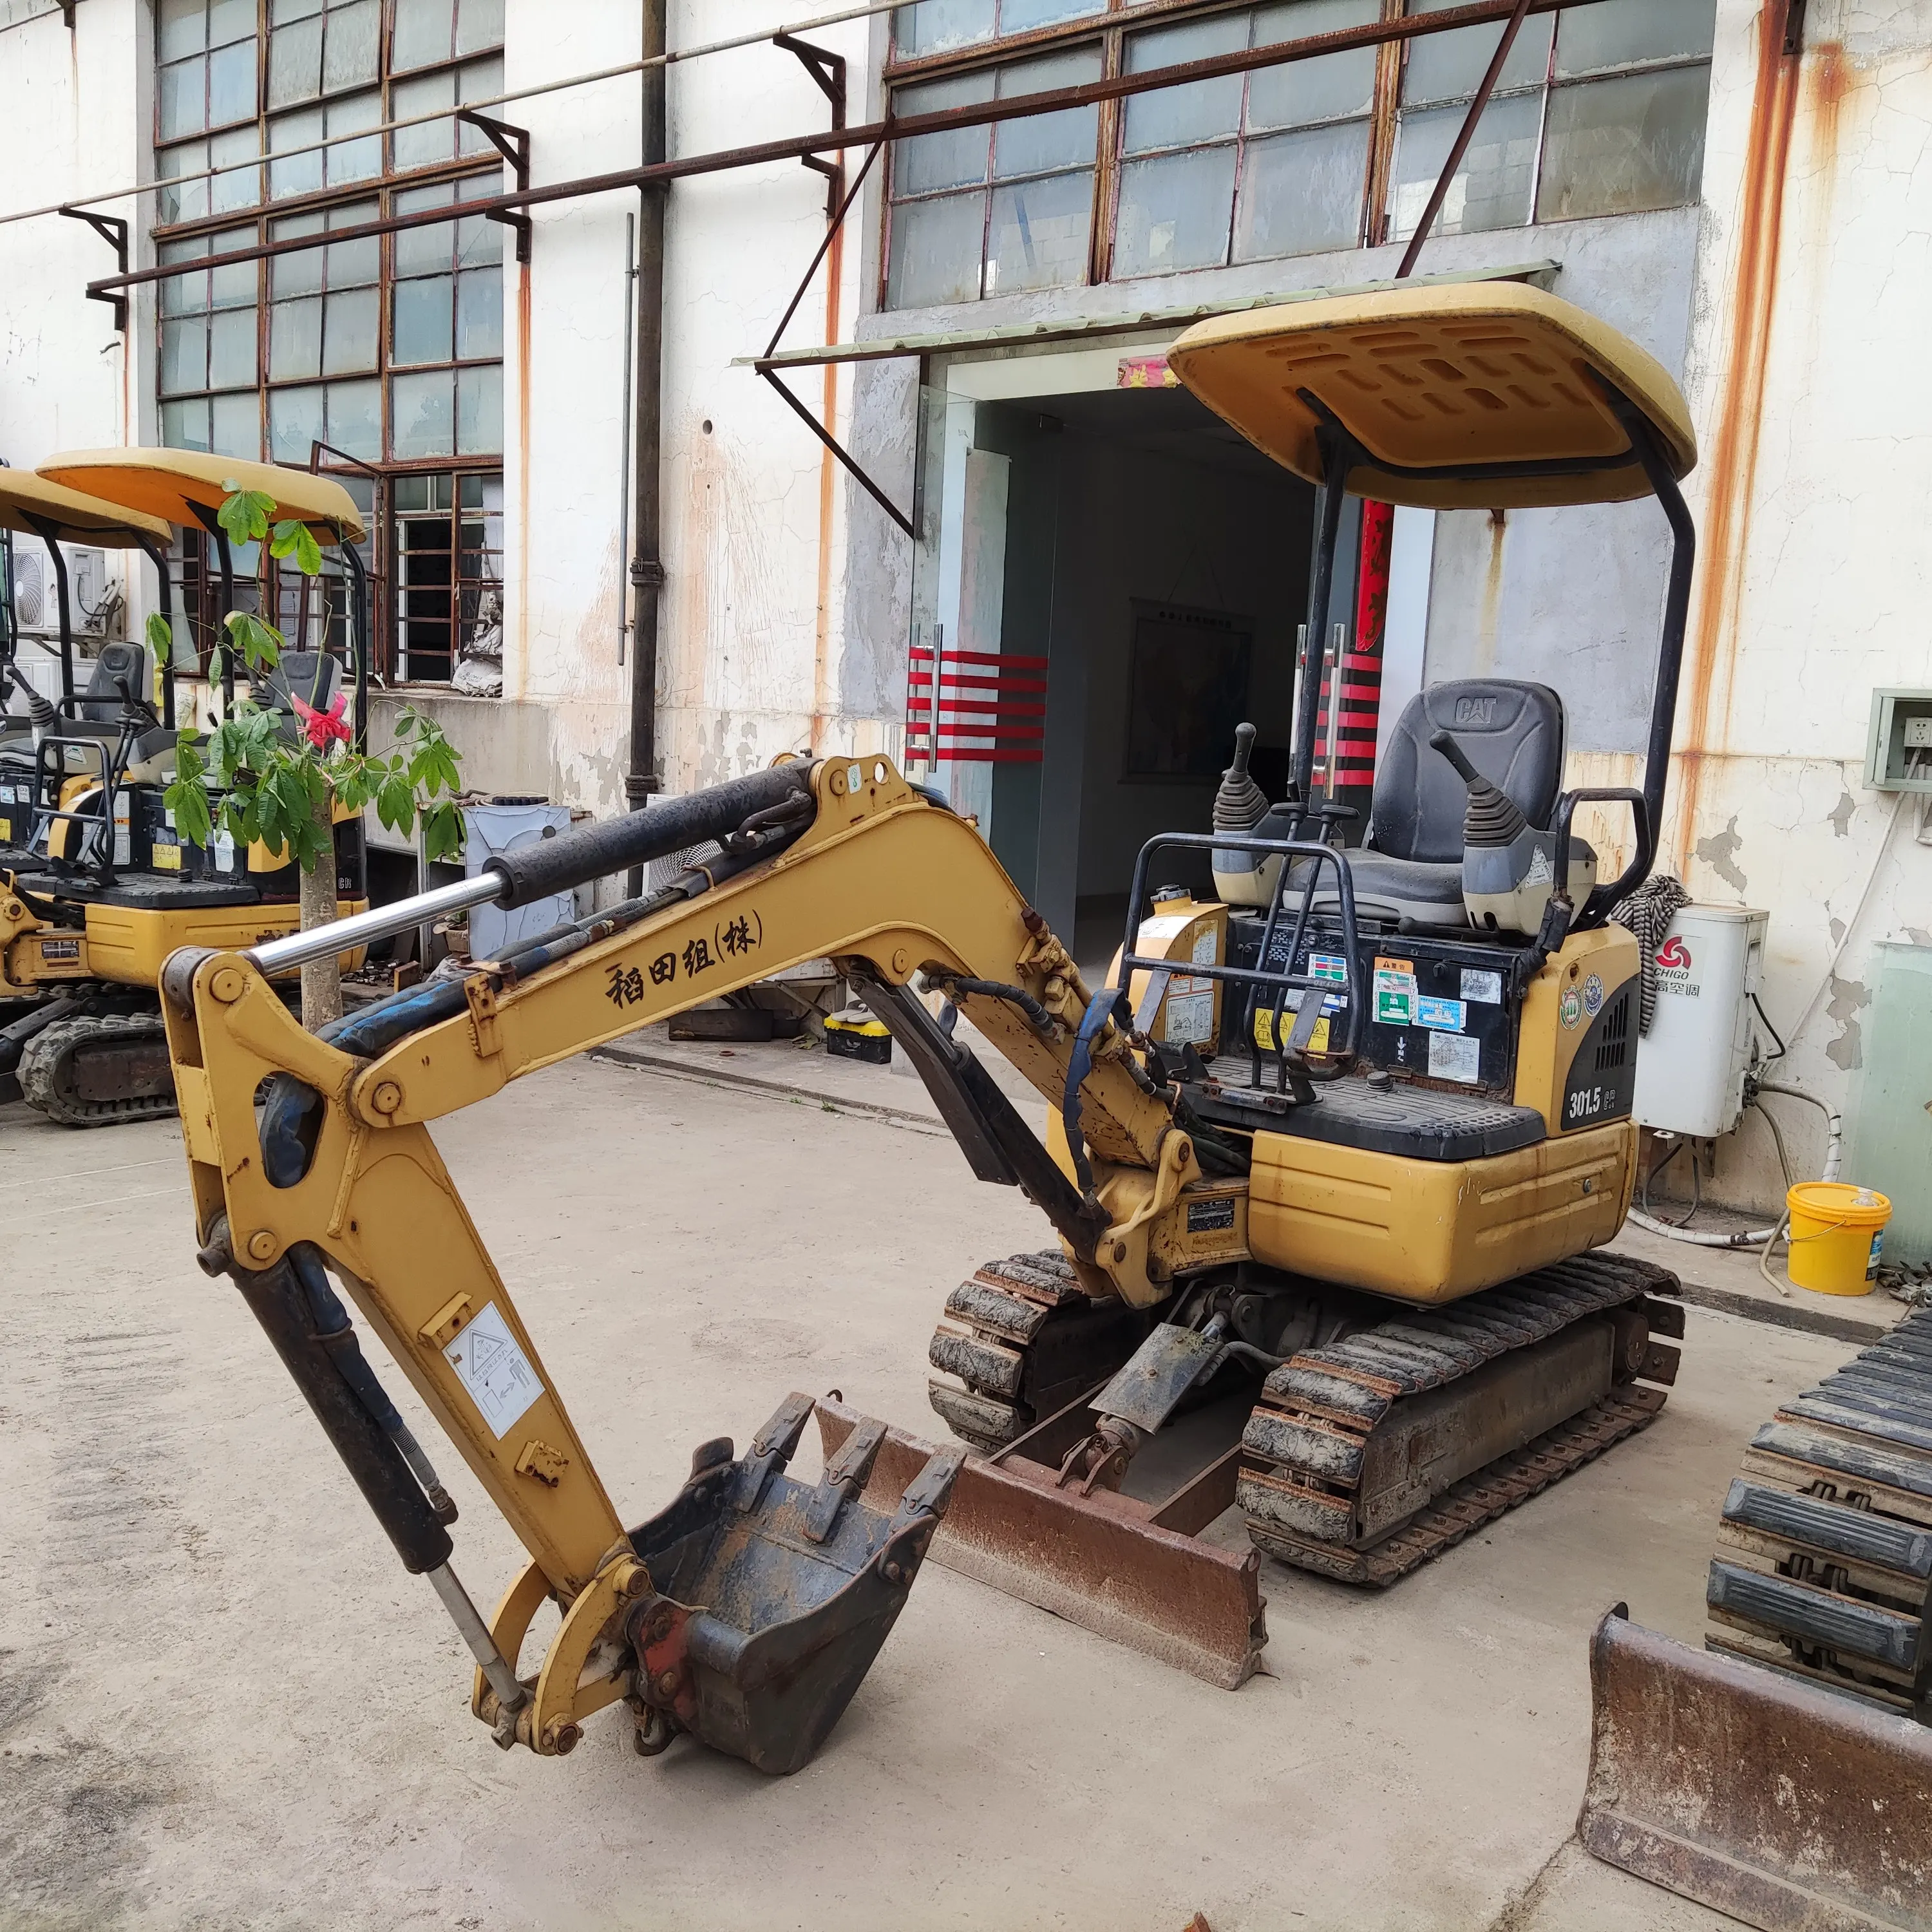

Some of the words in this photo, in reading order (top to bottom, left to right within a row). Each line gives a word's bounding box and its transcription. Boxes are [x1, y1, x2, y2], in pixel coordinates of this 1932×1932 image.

[1455, 696, 1497, 724] CAT
[338, 877, 352, 889] CR
[1653, 967, 1689, 980] CHIGO
[1569, 1086, 1602, 1119] 301.5
